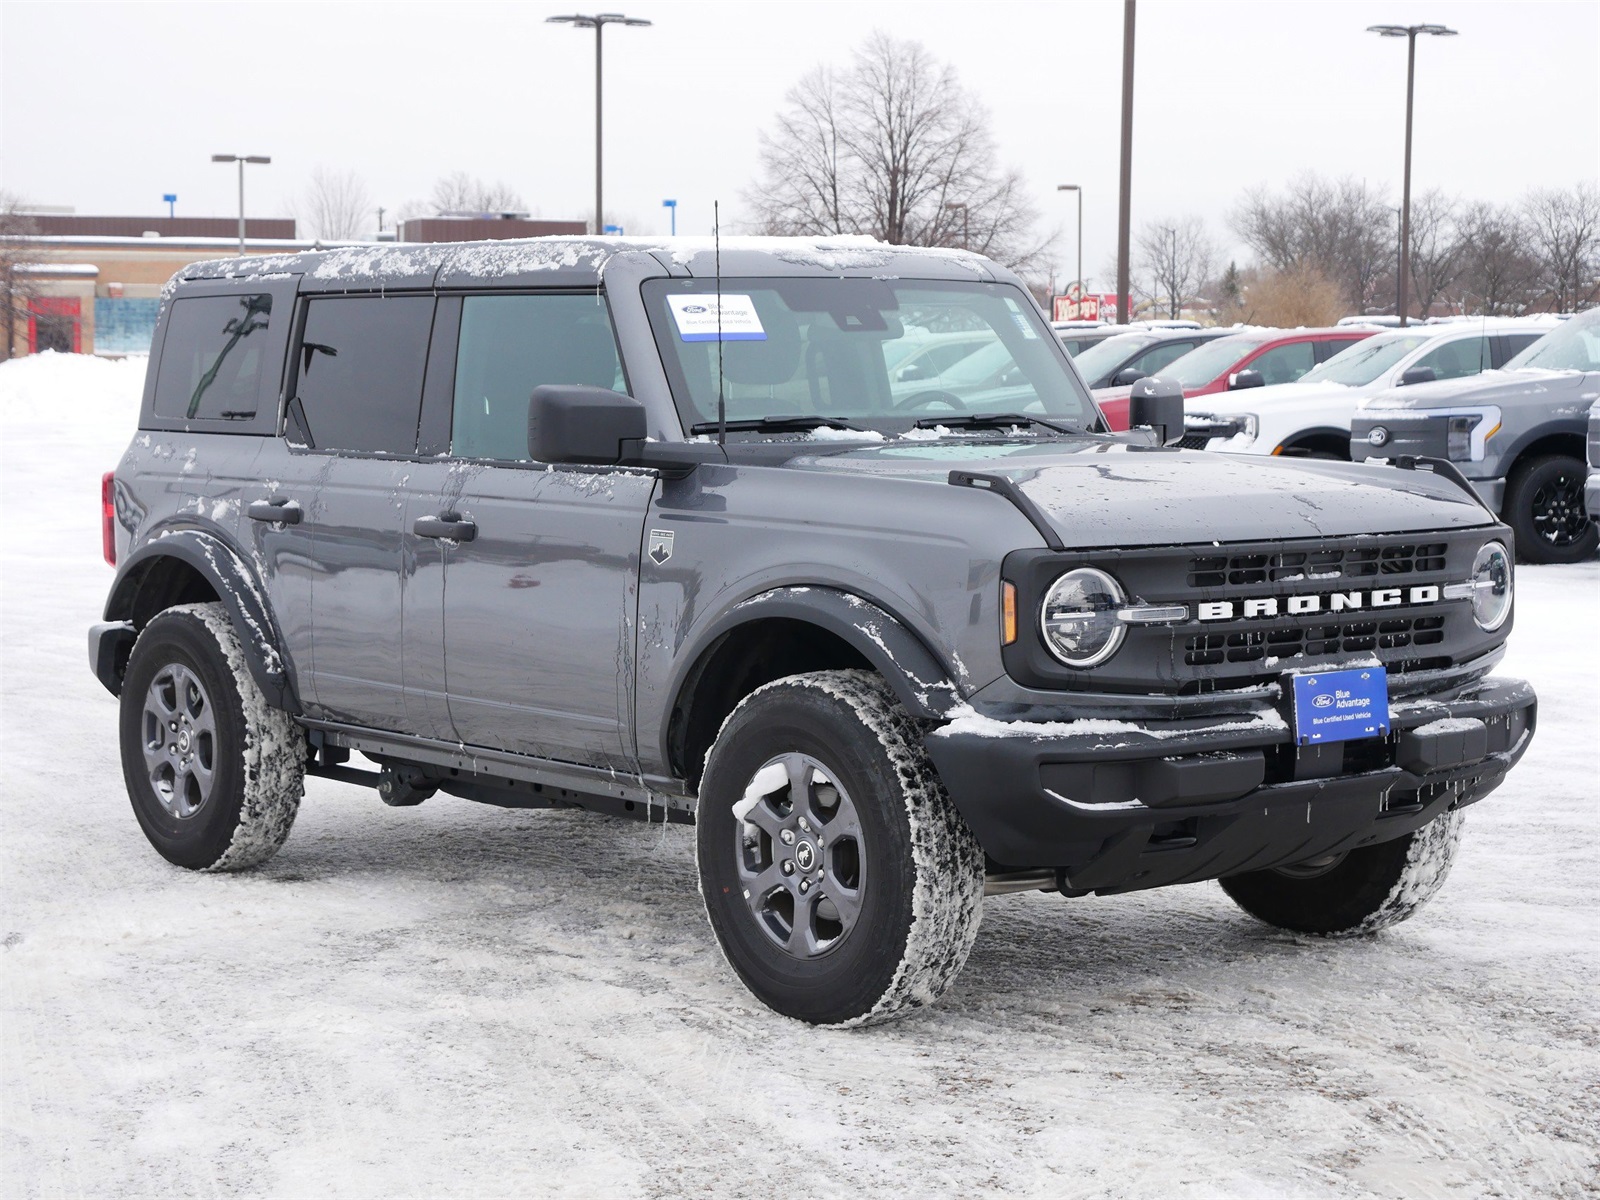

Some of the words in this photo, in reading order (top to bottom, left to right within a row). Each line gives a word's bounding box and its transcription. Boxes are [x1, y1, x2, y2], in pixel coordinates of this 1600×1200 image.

[1198, 585, 1439, 621] BRONCO
[1335, 690, 1350, 699] Blue
[1336, 697, 1371, 708] Advantage
[1323, 715, 1343, 724] Certified
[1355, 711, 1372, 719] Vehicle
